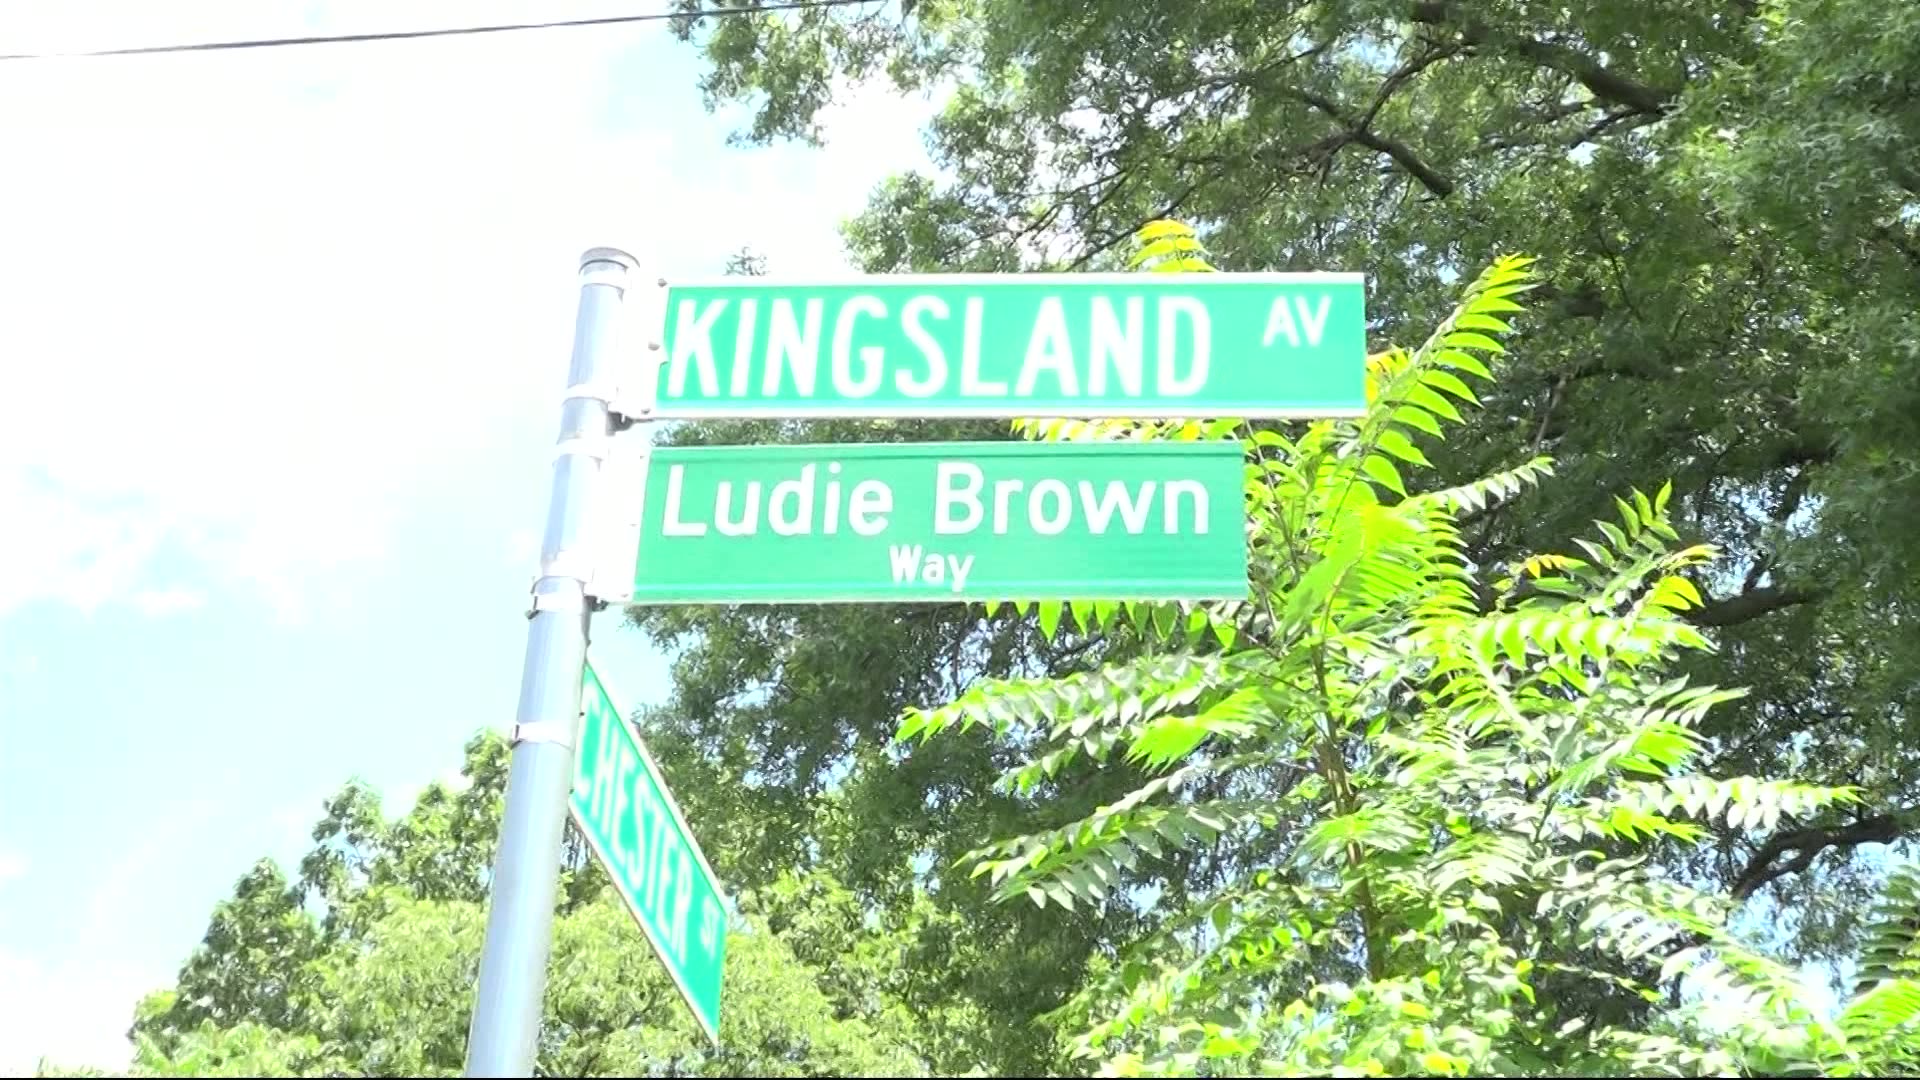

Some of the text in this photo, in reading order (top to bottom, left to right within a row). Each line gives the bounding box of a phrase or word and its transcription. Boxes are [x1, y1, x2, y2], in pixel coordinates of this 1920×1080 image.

[667, 294, 1331, 398] KINGSLAND AV
[661, 460, 1211, 538] Ludie Brown
[889, 544, 976, 592] Way
[573, 683, 694, 967] CHESTER
